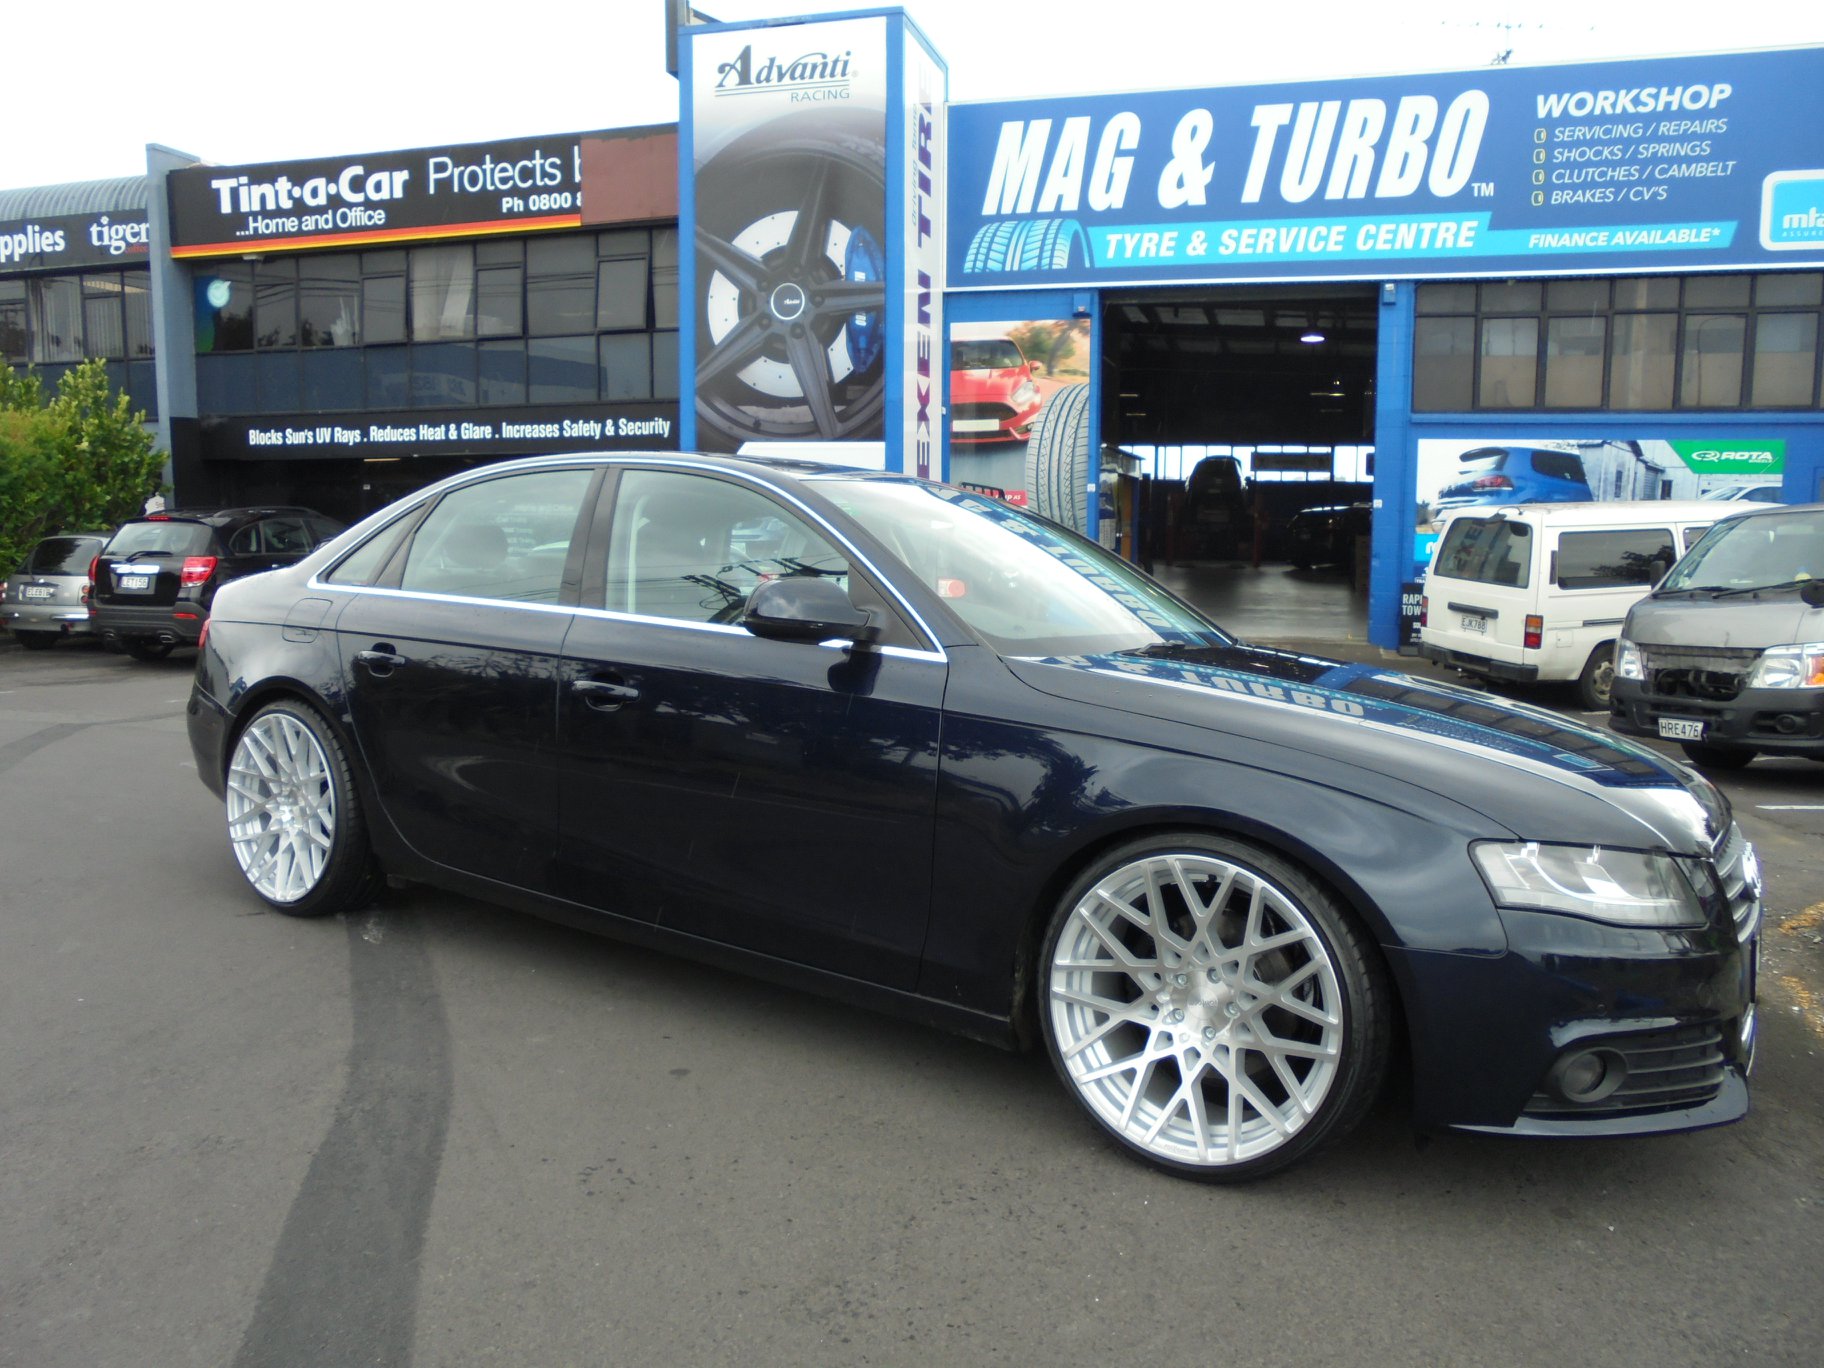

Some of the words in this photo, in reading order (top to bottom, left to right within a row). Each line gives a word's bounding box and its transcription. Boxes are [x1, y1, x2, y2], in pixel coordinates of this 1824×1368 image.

[715, 44, 851, 88] Advanti
[790, 88, 850, 103] RACING
[1537, 83, 1733, 118] WORKSHOP
[1553, 122, 1644, 142] SERVICING
[1658, 118, 1728, 137] REPAIRS
[981, 111, 1141, 216] MAG
[1157, 108, 1216, 209] &
[1240, 89, 1490, 203] TURBO
[1552, 144, 1623, 163] SHOCKS
[1637, 140, 1712, 158] SPRINGS
[429, 149, 562, 195] Protects
[1551, 165, 1640, 184] CLUTCHES
[1654, 160, 1737, 179] CAMBELT
[502, 197, 524, 213] Ph
[528, 192, 572, 211] 0800
[1550, 188, 1615, 205] BRAKES
[301, 209, 333, 231] and
[336, 206, 386, 228] Office
[90, 215, 149, 255] tiger
[1106, 231, 1179, 259] TYRE
[1186, 230, 1208, 256] &
[1218, 225, 1347, 256] SERVICE
[1356, 221, 1478, 251] CENTRE
[1529, 232, 1609, 248] FINANCE
[249, 429, 283, 445] Blocks
[285, 428, 313, 444] Sun's
[316, 427, 331, 443] UV
[334, 426, 361, 445] Rays
[369, 425, 416, 442] Reduces
[419, 424, 446, 441] Heat
[448, 423, 458, 439] &
[460, 422, 492, 440] Glare
[502, 421, 560, 438] Increases
[562, 418, 602, 439] Safety
[605, 419, 615, 436] &
[618, 417, 670, 438] Security
[1721, 451, 1773, 460] ROTA
[1660, 721, 1700, 738] HRE476
